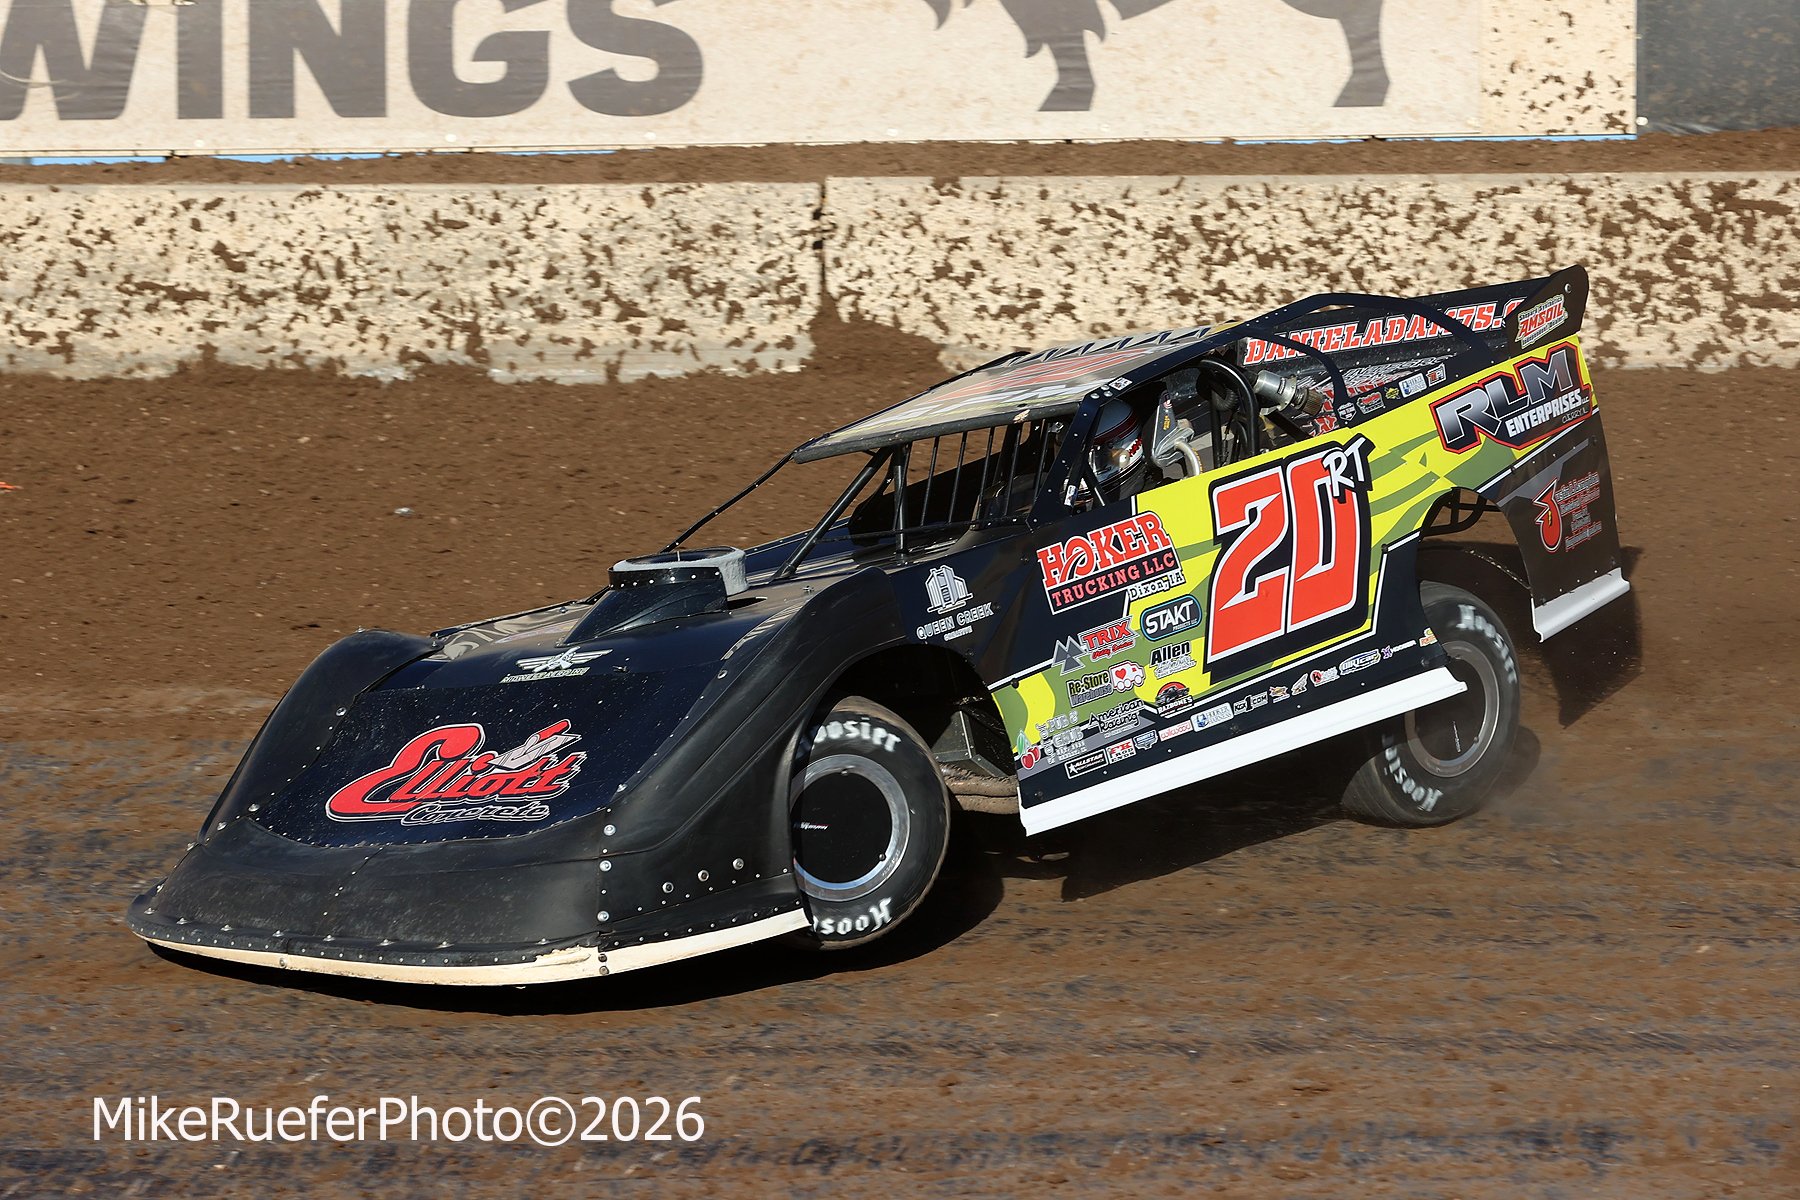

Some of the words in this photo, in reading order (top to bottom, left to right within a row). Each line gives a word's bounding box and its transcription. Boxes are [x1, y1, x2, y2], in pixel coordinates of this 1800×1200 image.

[1519, 302, 1564, 337] AMSOIL
[1436, 349, 1573, 444] RLM
[1505, 388, 1582, 437] ENTERPRISES
[1323, 437, 1366, 497] RT
[1037, 512, 1173, 588] HOKER
[1207, 447, 1360, 664] 20
[1052, 566, 1141, 607] TRUCKING
[1142, 552, 1176, 576] LLC
[1169, 572, 1185, 586] IA
[917, 616, 955, 640] QUEEN
[956, 602, 994, 626] CREEK
[1145, 600, 1194, 634] STAKT
[1083, 622, 1132, 650] TRIX
[1151, 641, 1190, 666] Allen
[1069, 672, 1109, 696] Re-Store
[1072, 686, 1113, 705] Warehouse
[1089, 699, 1143, 725] American
[1100, 712, 1140, 732] Racing
[809, 717, 901, 753] oosier
[326, 722, 587, 822] Elliott
[1384, 745, 1443, 812] Hoosie
[402, 802, 550, 826] Concrete
